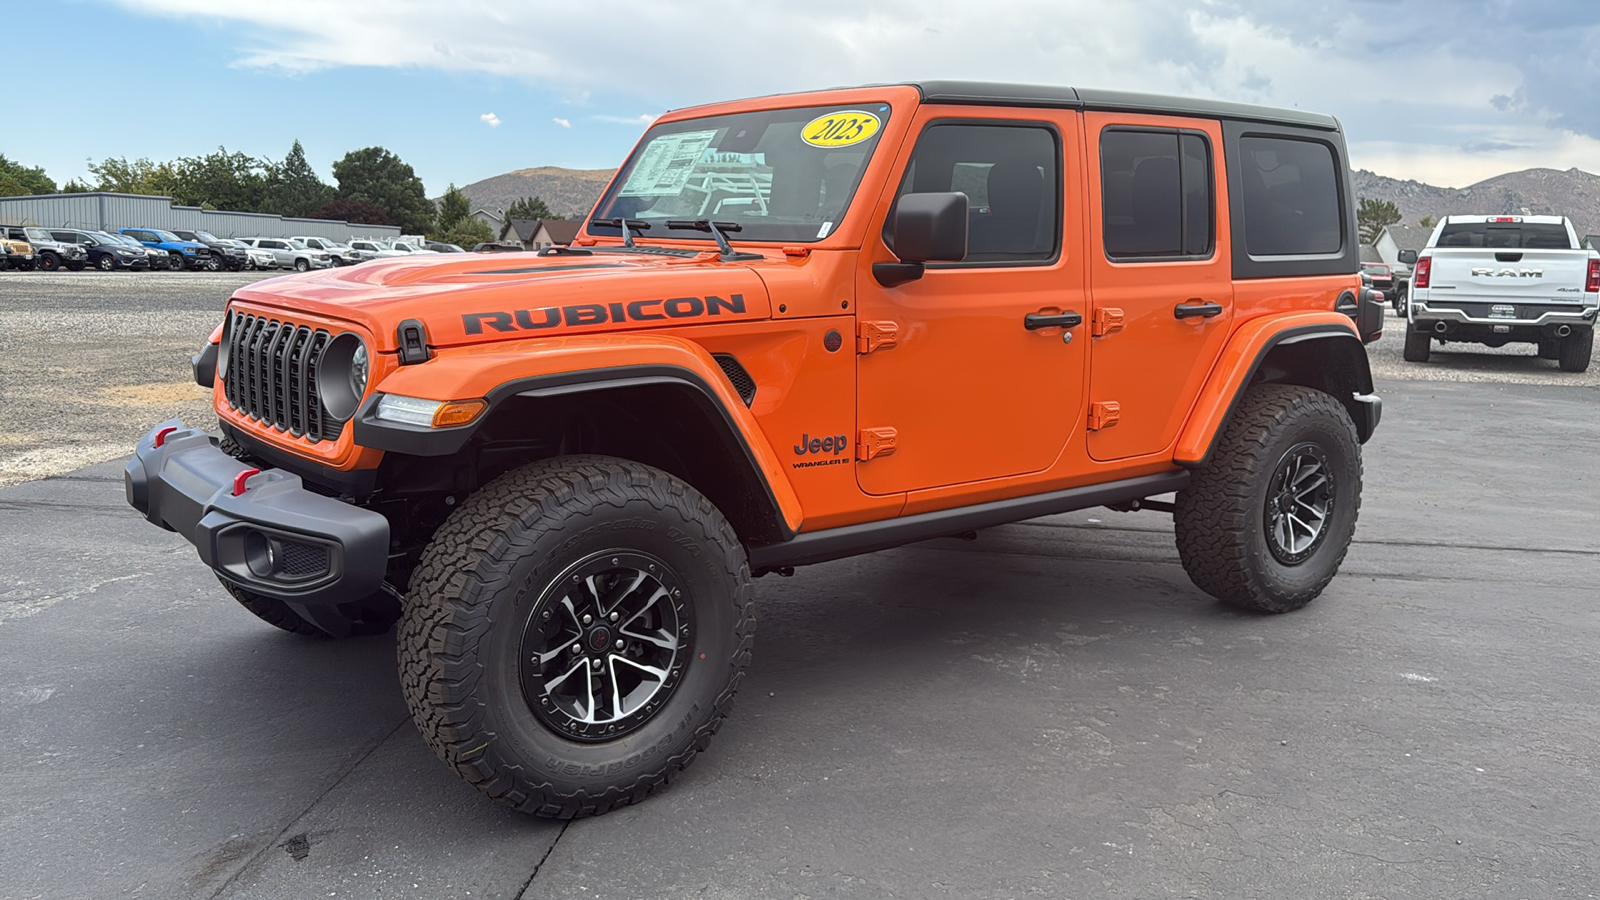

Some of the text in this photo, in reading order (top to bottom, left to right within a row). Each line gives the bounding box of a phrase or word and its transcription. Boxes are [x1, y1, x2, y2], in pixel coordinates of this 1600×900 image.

[810, 119, 872, 140] 2025
[1471, 268, 1543, 278] RAM
[461, 294, 747, 335] RUBICON
[794, 433, 847, 455] Jeep
[792, 459, 841, 469] WRANGLER
